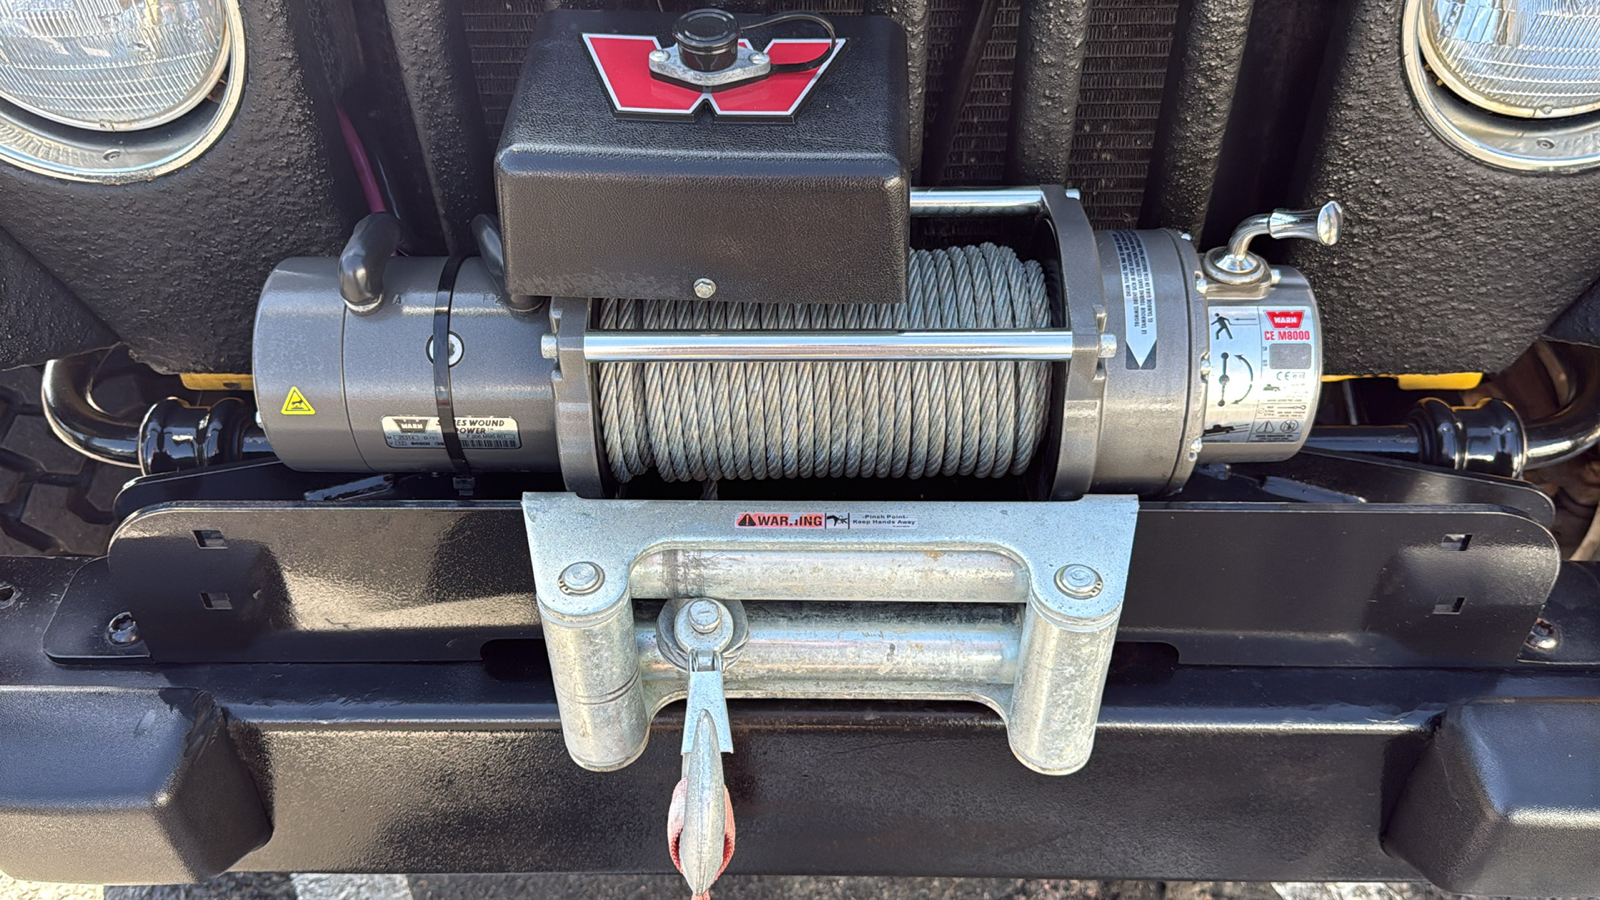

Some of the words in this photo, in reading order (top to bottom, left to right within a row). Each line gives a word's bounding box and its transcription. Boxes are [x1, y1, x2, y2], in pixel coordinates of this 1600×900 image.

[1264, 331, 1275, 341] CE
[1278, 330, 1311, 341] M8000
[469, 419, 505, 427] WOUND
